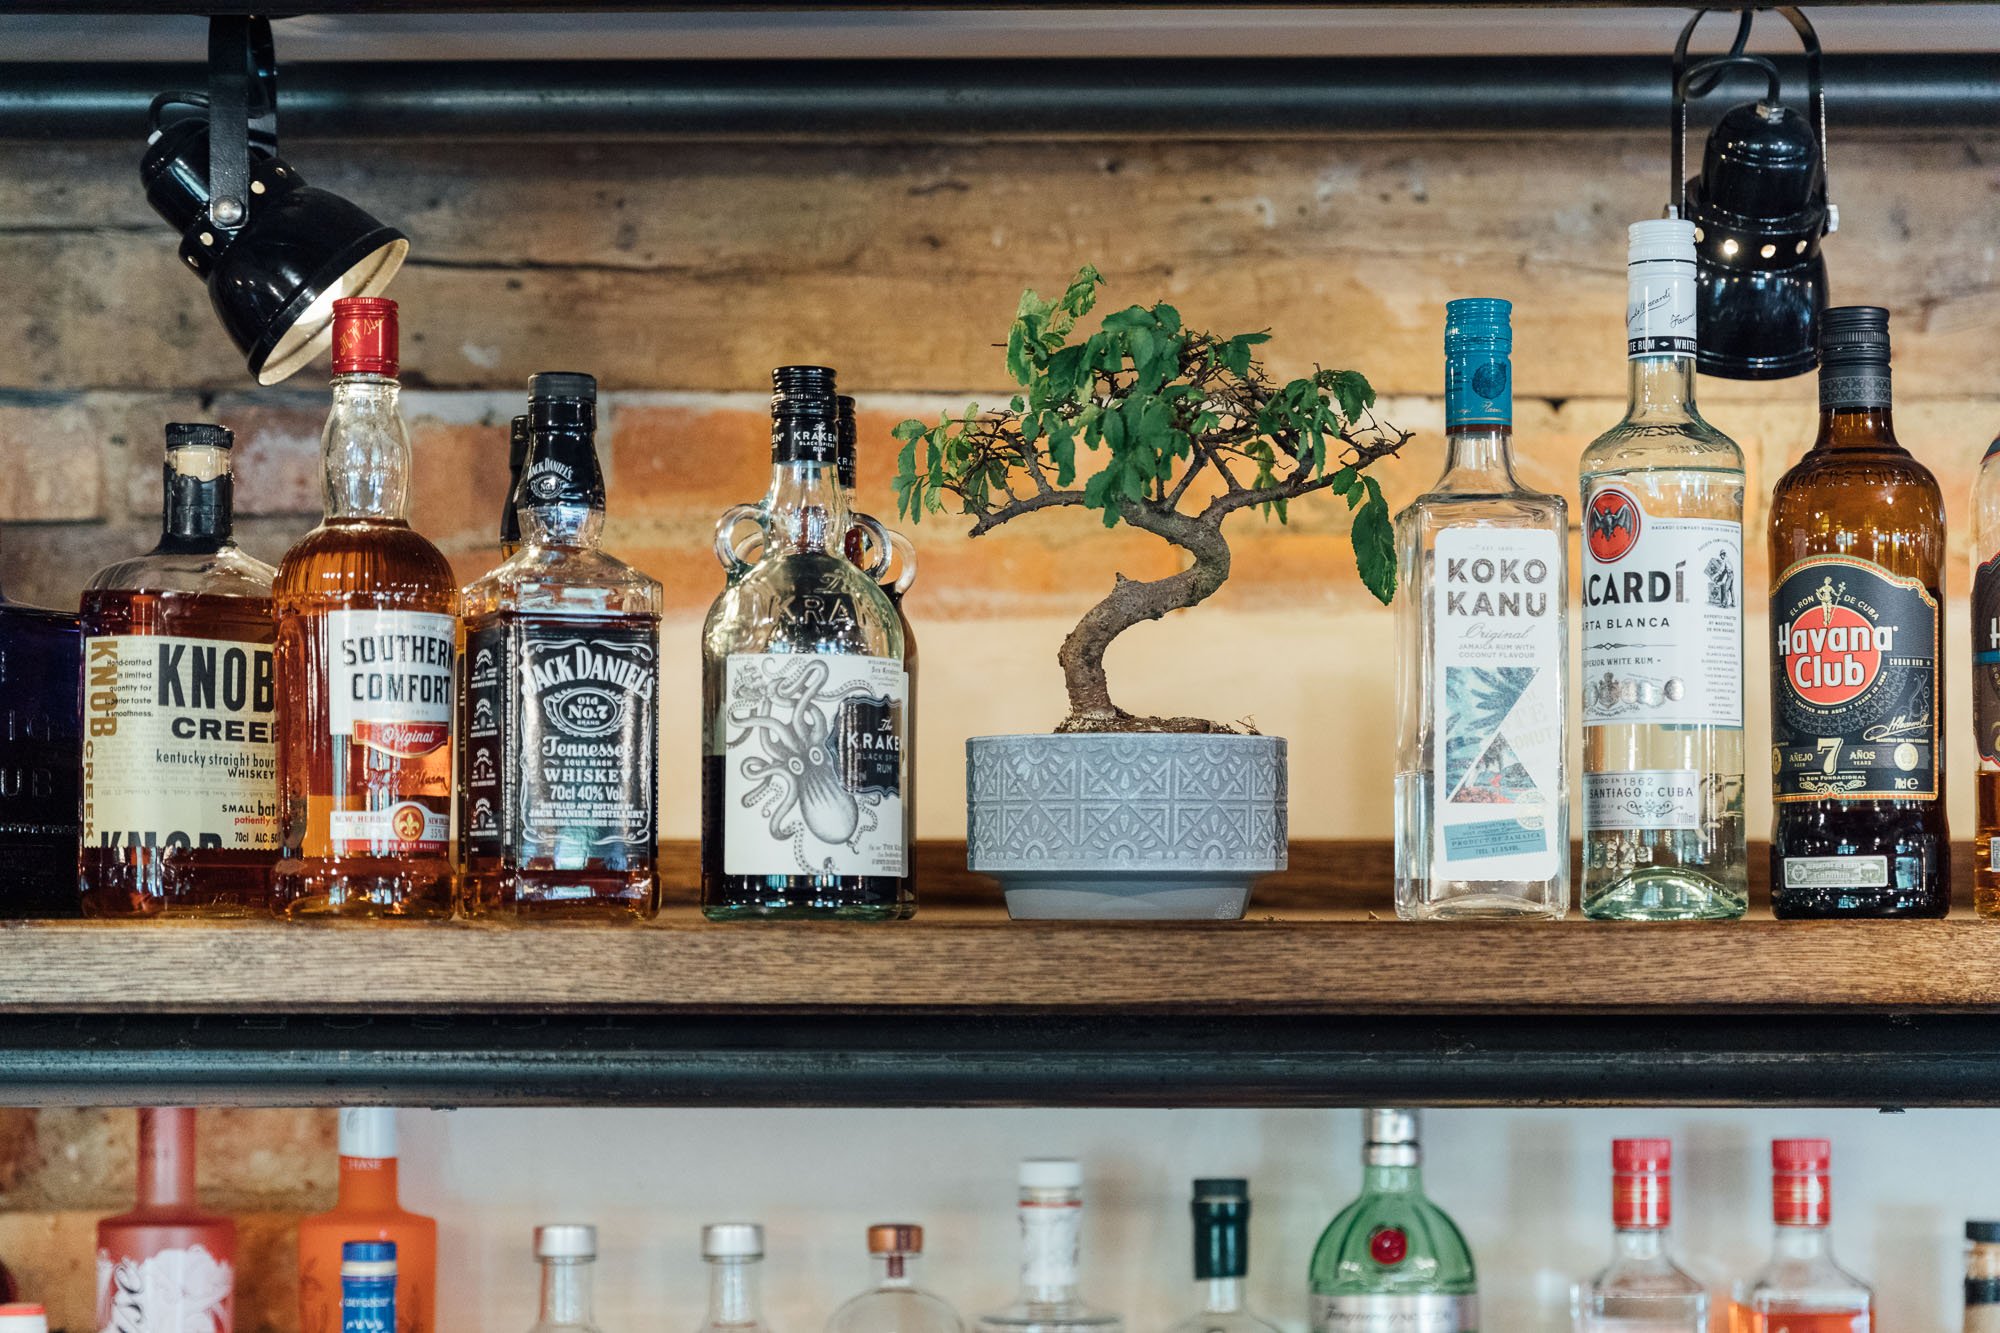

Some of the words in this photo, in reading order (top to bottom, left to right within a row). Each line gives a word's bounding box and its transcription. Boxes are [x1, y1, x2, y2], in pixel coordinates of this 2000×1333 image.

[1447, 557, 1547, 585] KOKO
[1447, 590, 1547, 618] KANU
[1789, 607, 1798, 617] EL
[1798, 595, 1814, 609] RON
[1843, 594, 1857, 604] DE
[1857, 600, 1880, 621] CUBA
[1606, 617, 1671, 629] BLANCA
[1458, 621, 1536, 646] Original
[1778, 622, 1893, 656] Havana
[342, 634, 454, 671] SOUTHERN
[1458, 643, 1493, 651] JAMAICA
[1495, 643, 1513, 651] RUM
[1458, 650, 1497, 659] COCONUT
[1498, 650, 1535, 659] FLAVOUR
[1606, 657, 1632, 666] WHITE
[1634, 656, 1654, 665] RUM
[158, 643, 275, 712] KNOB
[519, 654, 576, 695] JACK
[576, 646, 656, 701] DANIEL'S
[1795, 653, 1866, 689] Club
[90, 640, 118, 738] KNOB
[109, 684, 138, 693] quantity
[140, 684, 152, 692] for
[352, 672, 451, 704] COMFORT
[577, 696, 599, 706] Old
[567, 704, 609, 720] No.7
[877, 718, 894, 732] The
[382, 726, 435, 747] Original
[541, 735, 634, 758] Tennessee
[156, 748, 206, 768] kentucky
[208, 753, 250, 769] straight
[564, 759, 587, 767] SOUR
[1789, 751, 1814, 763] AÑEJO
[1816, 737, 1844, 776] 7
[1849, 749, 1876, 761] AÑOS
[227, 768, 275, 779] WHISKEY
[543, 768, 633, 783] WHISKEY
[876, 763, 893, 774] RUM
[85, 740, 94, 839] CREEK
[1623, 776, 1654, 787] 1862
[550, 784, 576, 801] 70cl
[577, 784, 604, 801] 40%
[1588, 786, 1642, 799] SANTIAGO
[1657, 786, 1694, 798] CUBA
[221, 804, 255, 813] SMALL
[234, 815, 271, 826] patiently
[235, 832, 249, 843] 70cl
